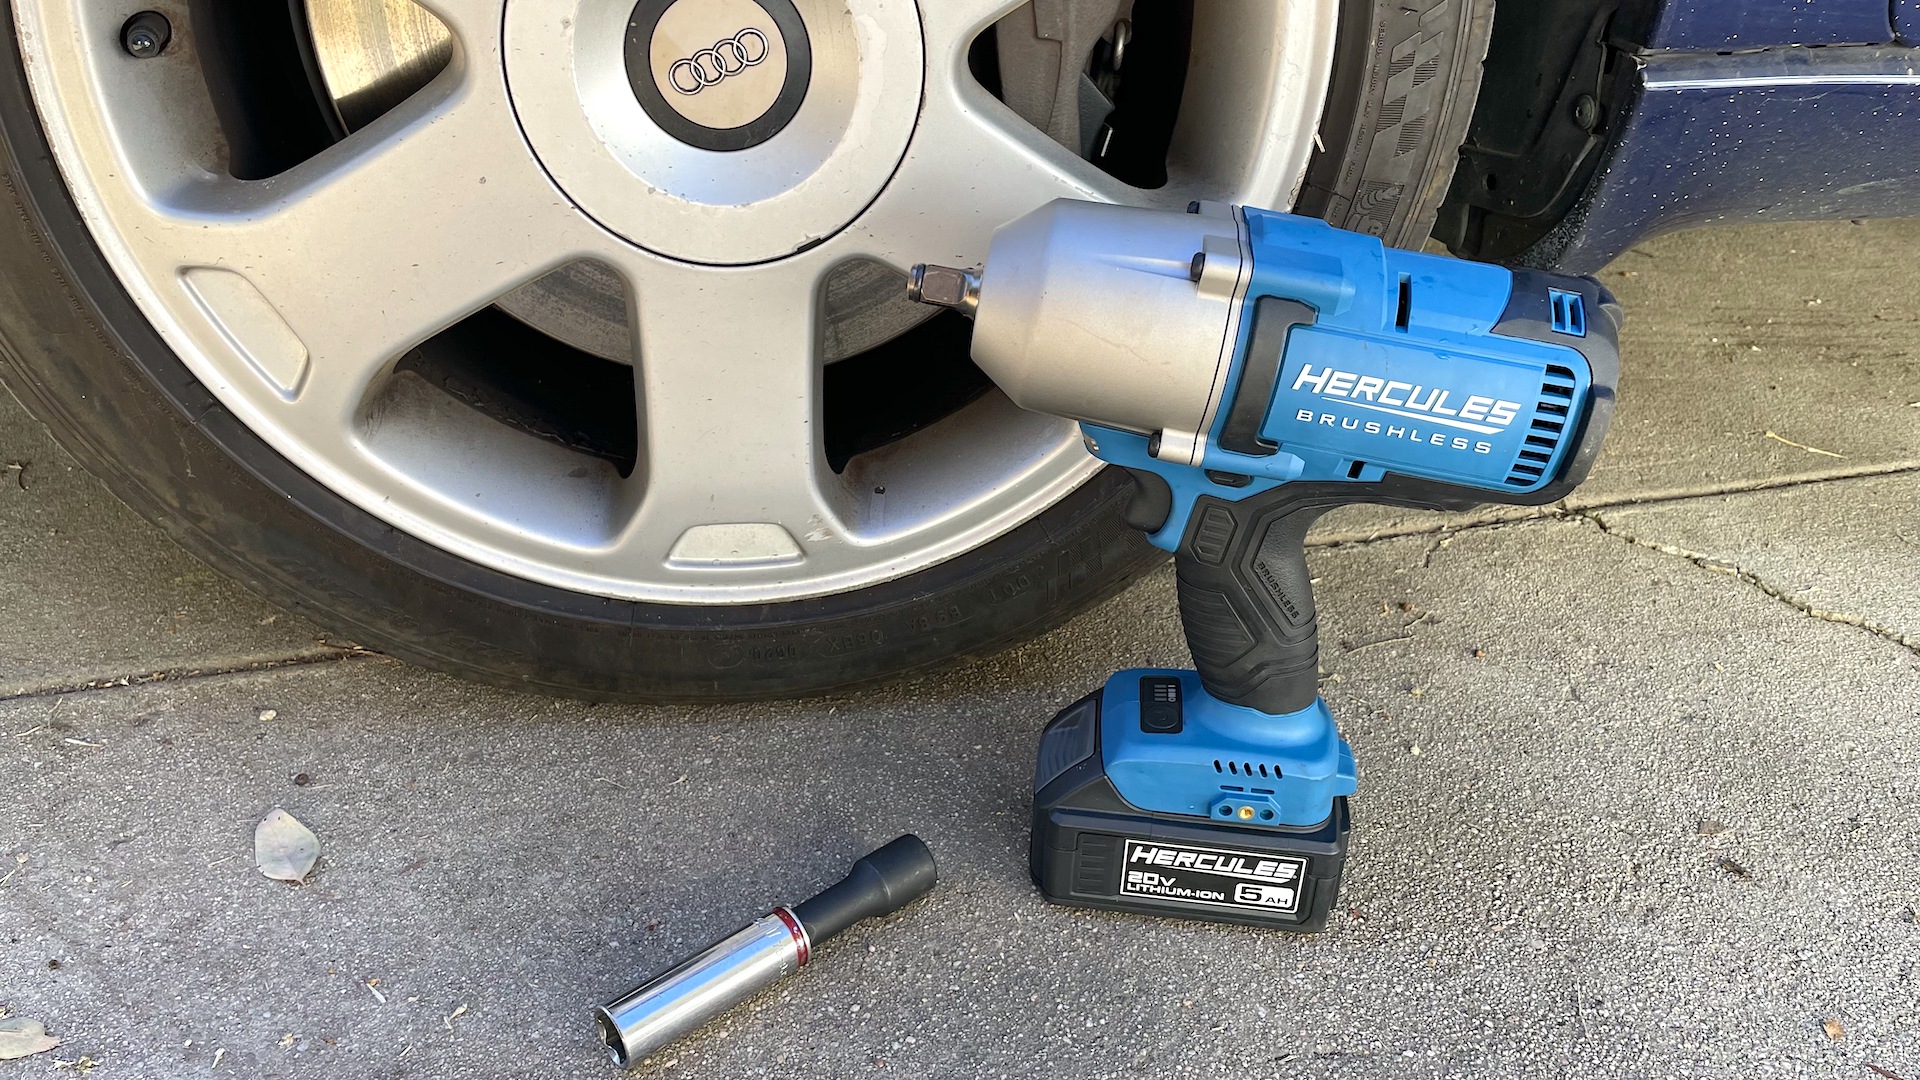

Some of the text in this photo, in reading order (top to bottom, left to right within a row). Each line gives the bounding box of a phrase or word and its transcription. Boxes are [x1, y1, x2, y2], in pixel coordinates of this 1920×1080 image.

[1291, 363, 1523, 425] HERCULES
[1295, 409, 1492, 455] BRUSHLESS
[1255, 561, 1300, 620] BRUSHLESS
[1127, 870, 1177, 887] 20V
[1130, 845, 1298, 880] HERCULES
[1126, 882, 1225, 902] LITHIUM-ION
